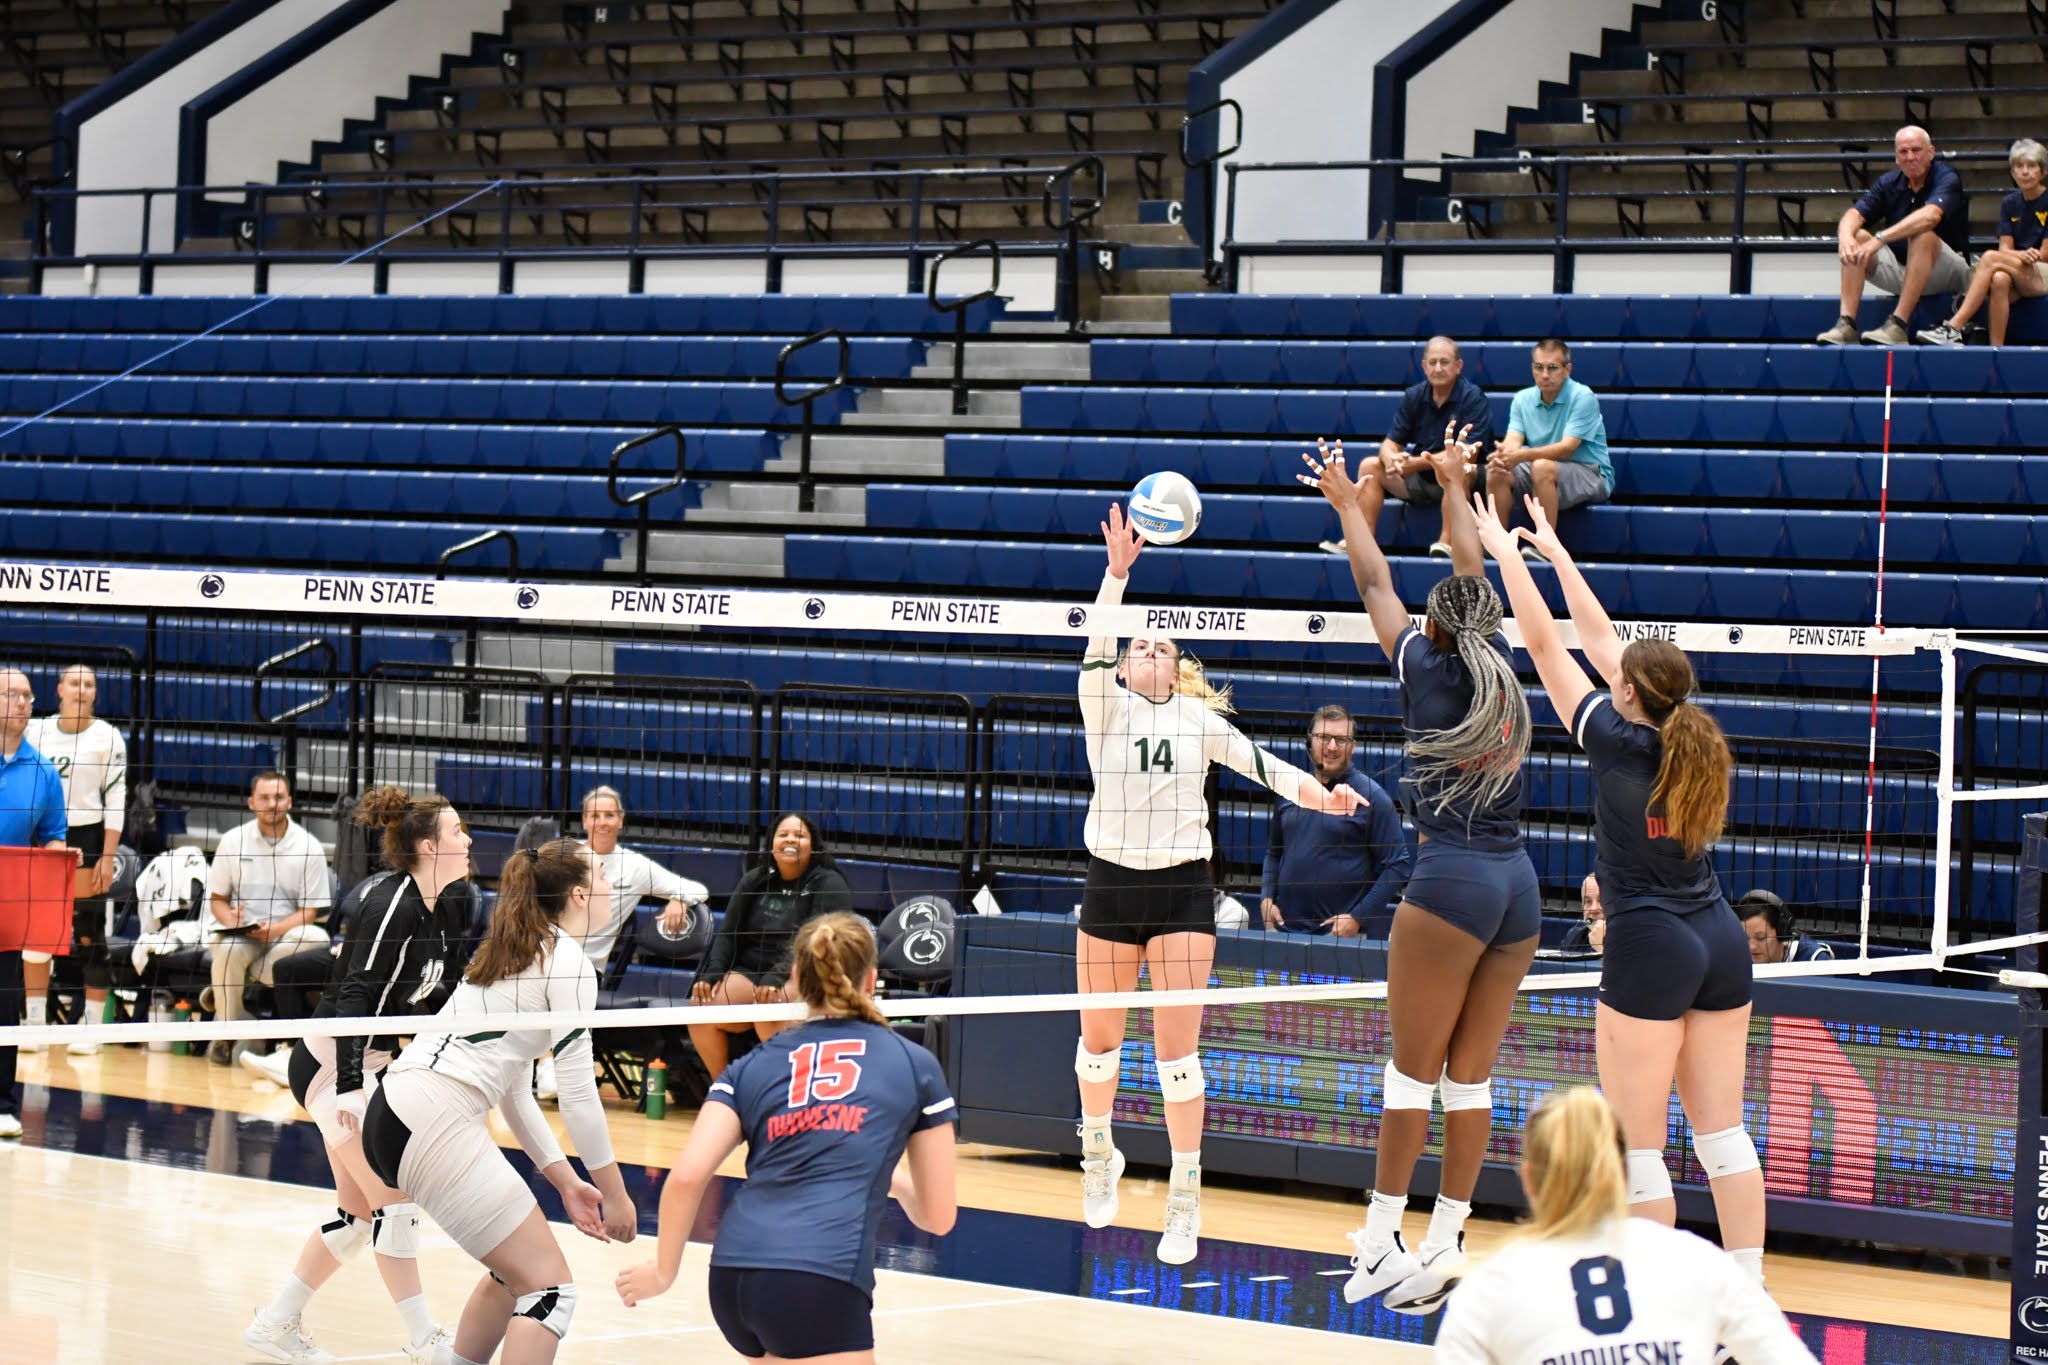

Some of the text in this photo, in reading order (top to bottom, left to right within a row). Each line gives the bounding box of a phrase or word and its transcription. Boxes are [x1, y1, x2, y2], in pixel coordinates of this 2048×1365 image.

[594, 7, 607, 23] H
[1702, 0, 1717, 21] G
[1168, 201, 1182, 225] C
[1448, 200, 1462, 223] C
[1098, 250, 1113, 270] B
[40, 568, 111, 592] STATE
[304, 579, 435, 604] PENN STATE
[611, 590, 731, 615] PENN STATE
[891, 600, 1000, 624] PENN STATE
[1146, 609, 1246, 631] PENN STATE
[1612, 623, 1677, 642] NN STATE
[1789, 627, 1866, 647] PENN STATE
[1134, 737, 1174, 773] 14
[788, 1039, 867, 1109] 15
[1204, 1048, 1303, 1106] STATE
[1570, 1255, 1633, 1336] 8
[1541, 1341, 1683, 1365] UESNE
[2016, 1345, 2037, 1357] REC
